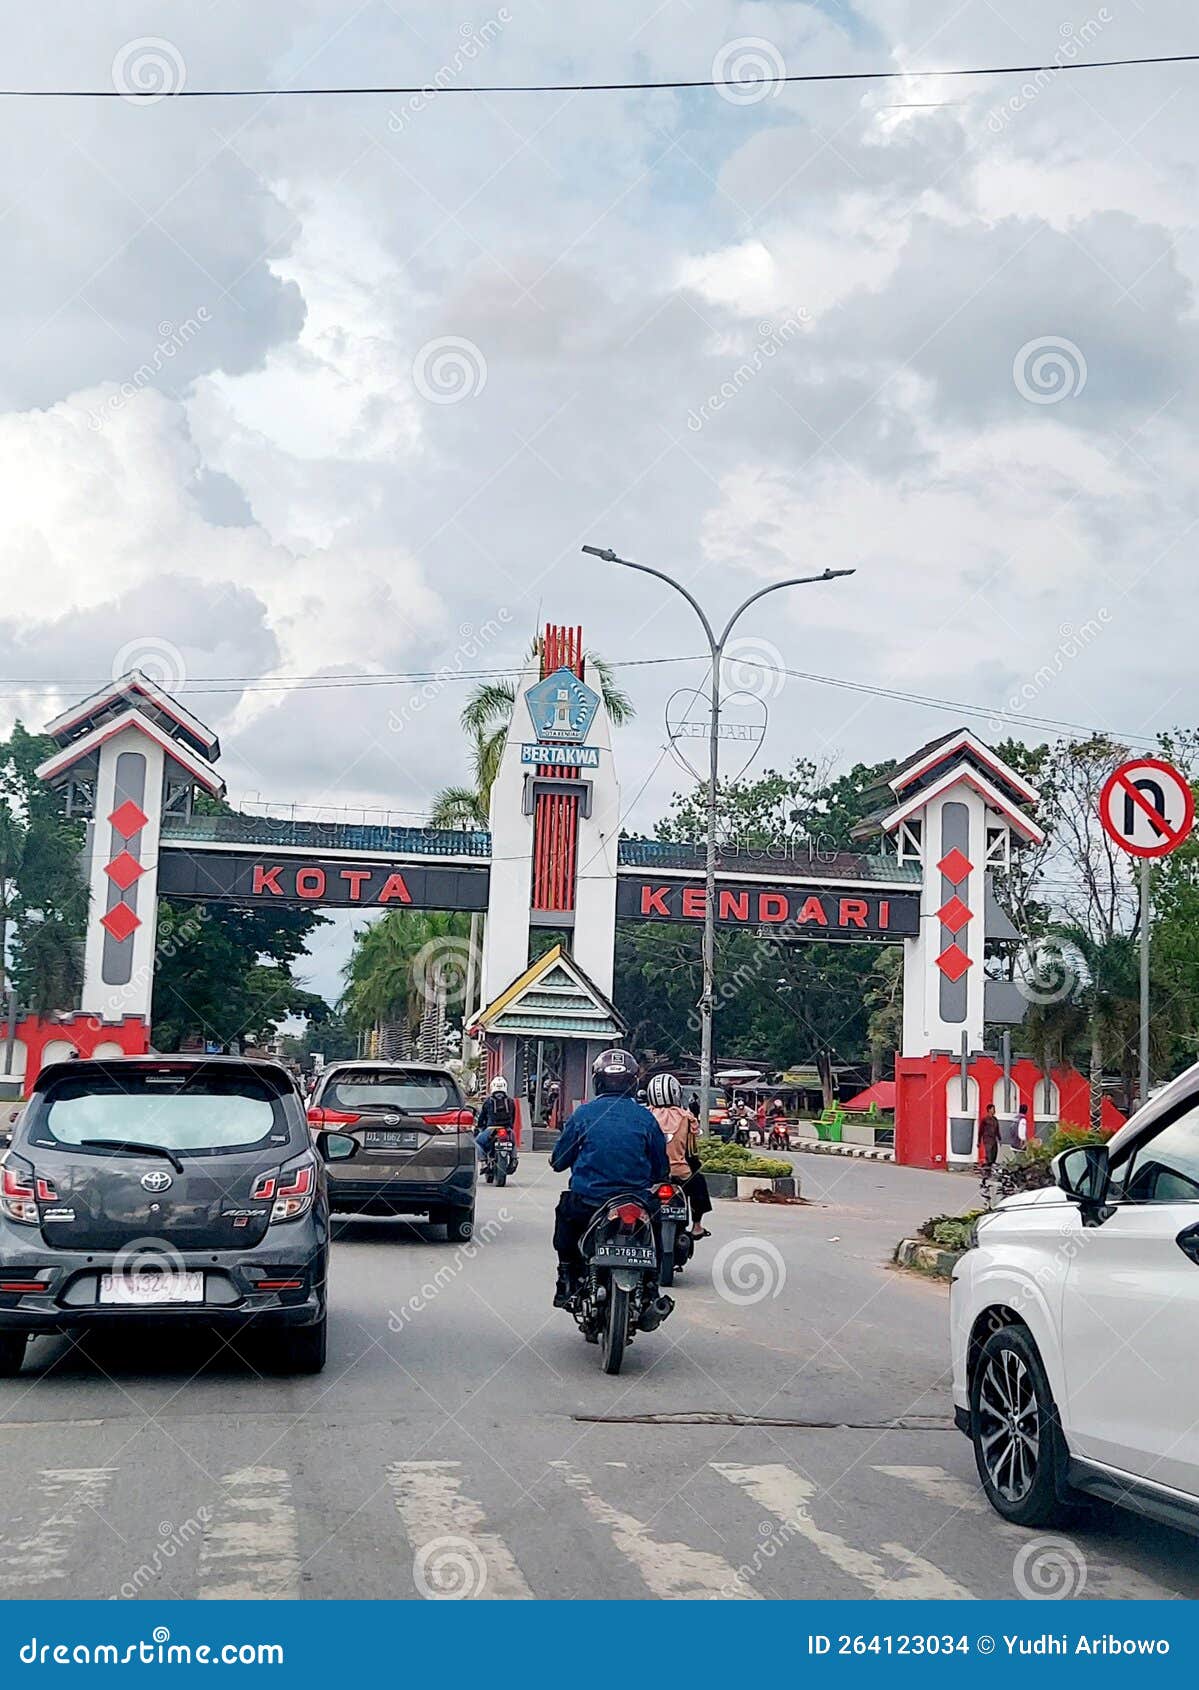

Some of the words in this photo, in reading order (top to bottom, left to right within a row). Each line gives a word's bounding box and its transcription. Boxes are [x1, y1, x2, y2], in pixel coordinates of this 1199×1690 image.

[521, 746, 598, 765] BERTAKWA
[252, 864, 413, 904] KOTA
[641, 885, 889, 929] KENDARI
[599, 1247, 610, 1256] DT
